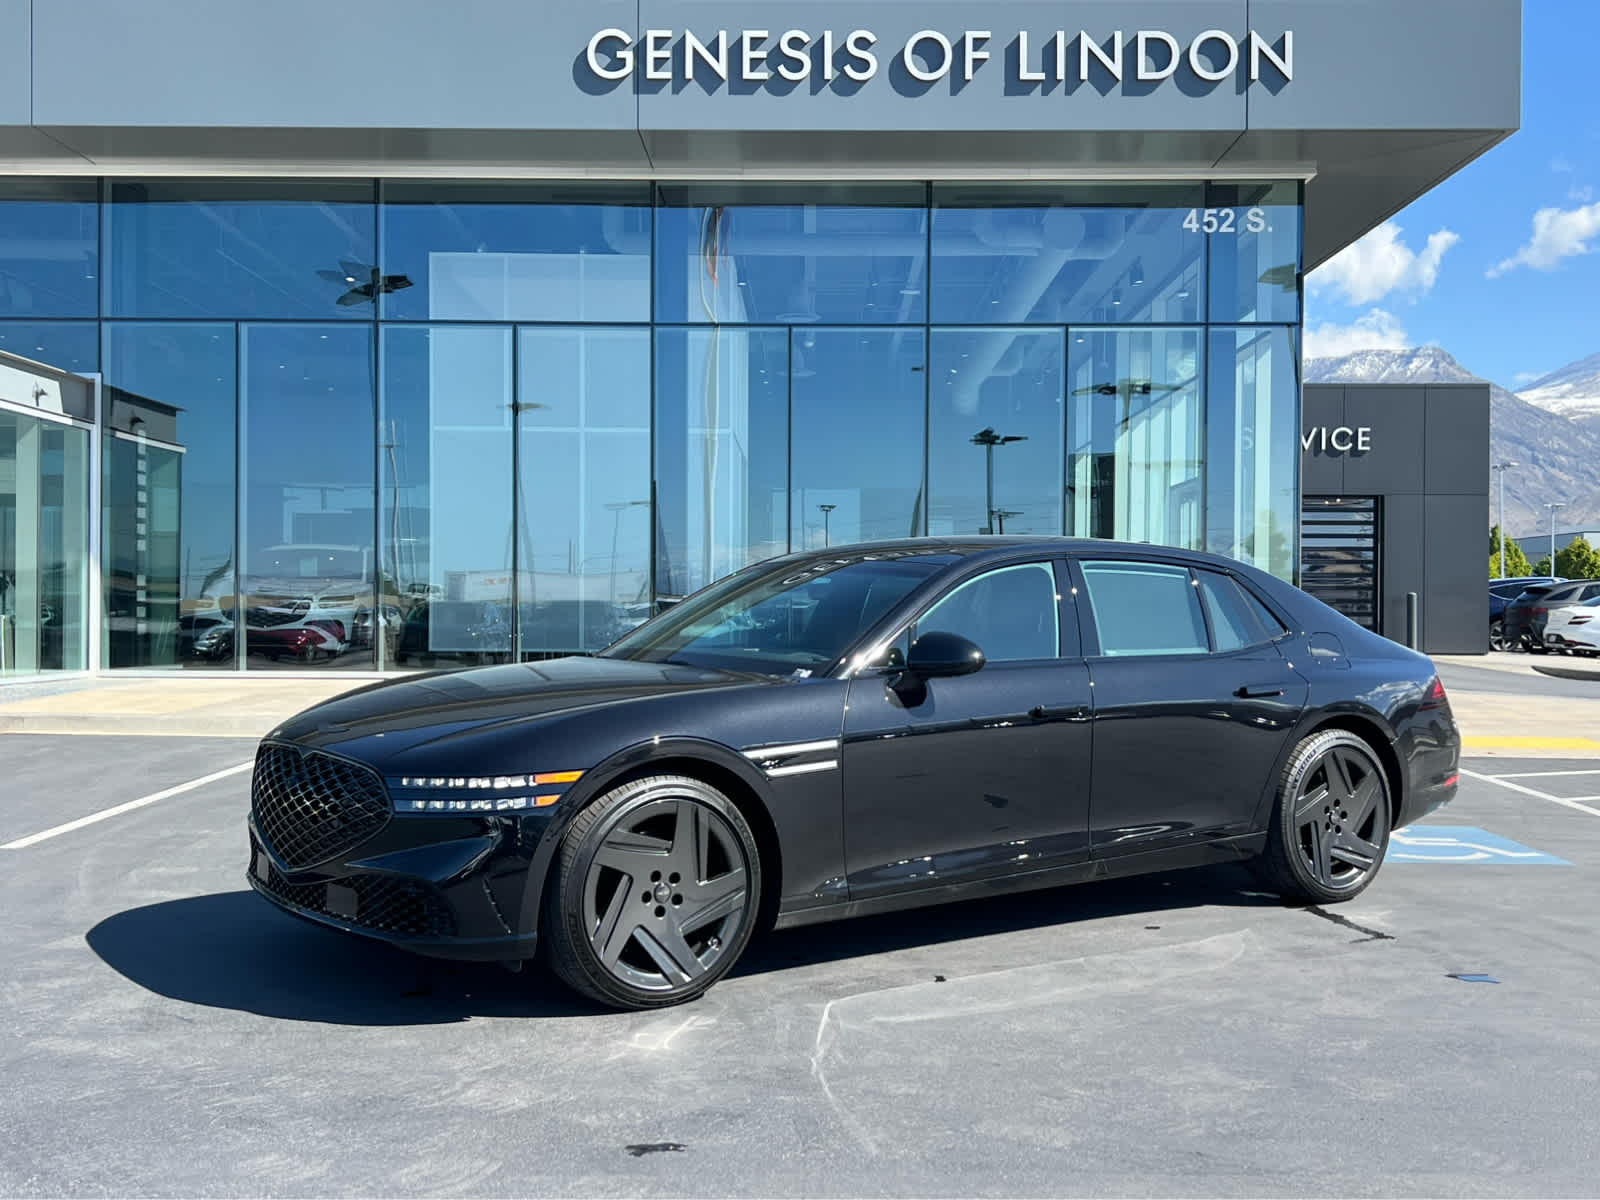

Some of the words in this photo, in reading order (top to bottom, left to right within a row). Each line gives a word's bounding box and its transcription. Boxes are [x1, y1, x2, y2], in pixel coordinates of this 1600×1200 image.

[586, 28, 878, 81] GENESIS
[904, 29, 991, 81] OF
[1018, 29, 1294, 81] LINDON
[1182, 208, 1235, 232] 452
[1246, 207, 1273, 232] S.
